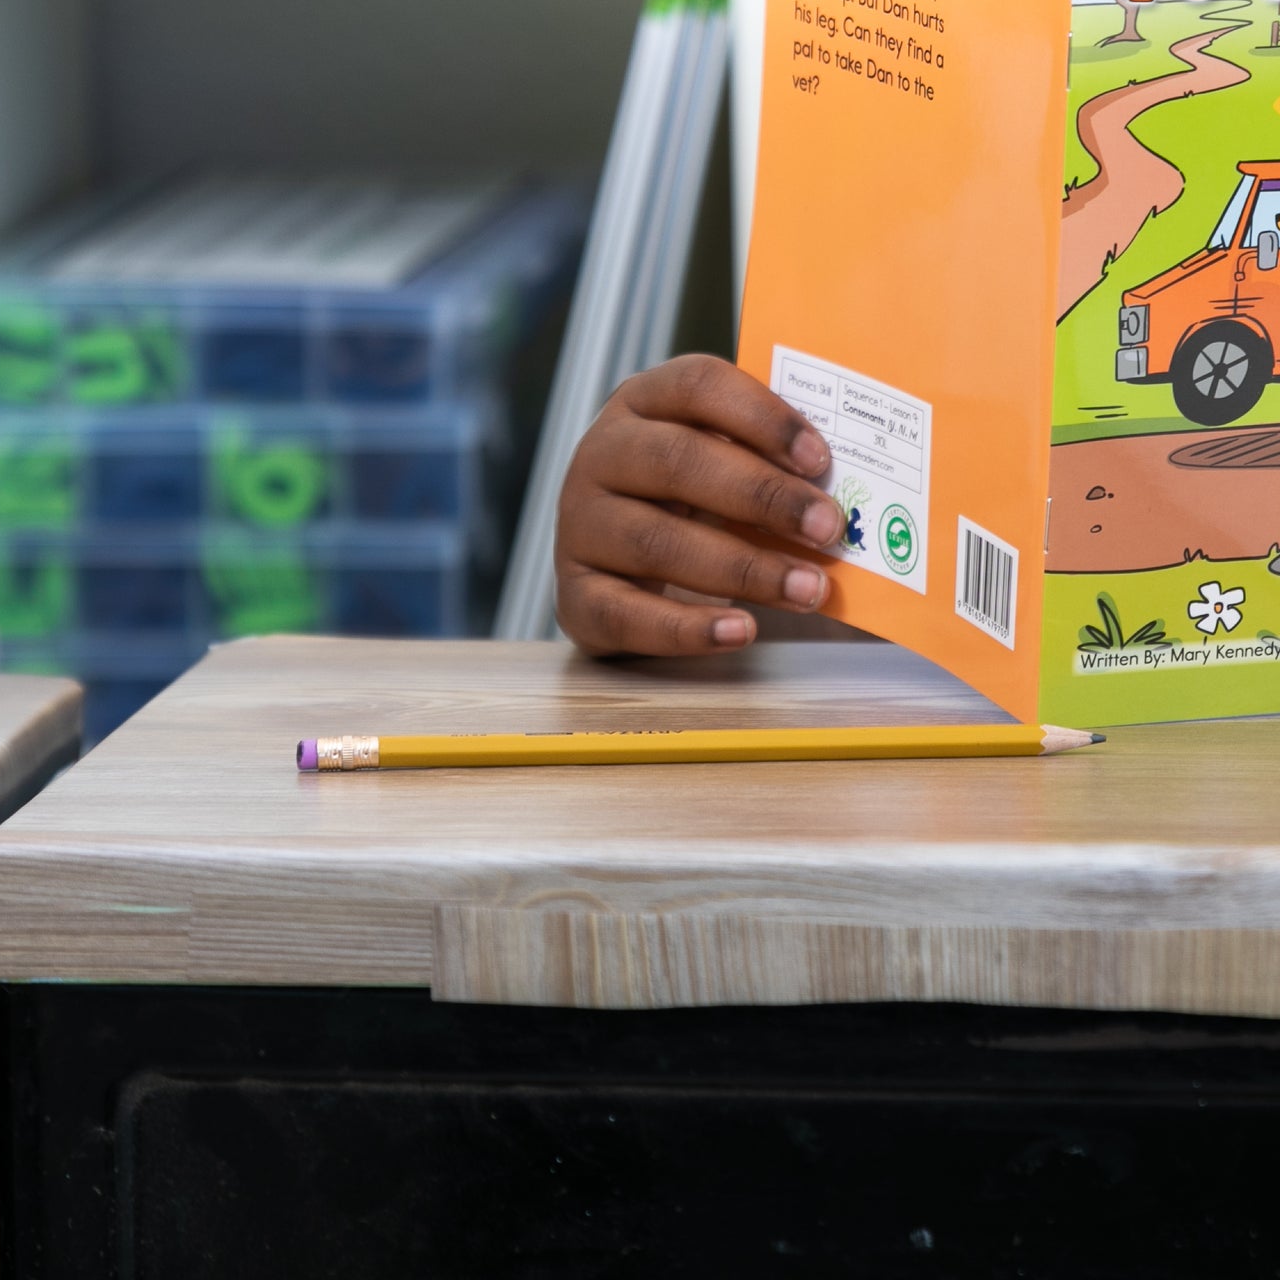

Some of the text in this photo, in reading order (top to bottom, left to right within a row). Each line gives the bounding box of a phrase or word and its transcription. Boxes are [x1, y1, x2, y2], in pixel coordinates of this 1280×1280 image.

[913, 3, 945, 34] hurts
[794, 0, 945, 69] his leg. Can they find a
[792, 74, 820, 96] vet?
[793, 39, 935, 101] pal to take Dan to the
[1079, 651, 1140, 670] Written
[1143, 650, 1167, 671] By:
[1170, 646, 1212, 670] Mary
